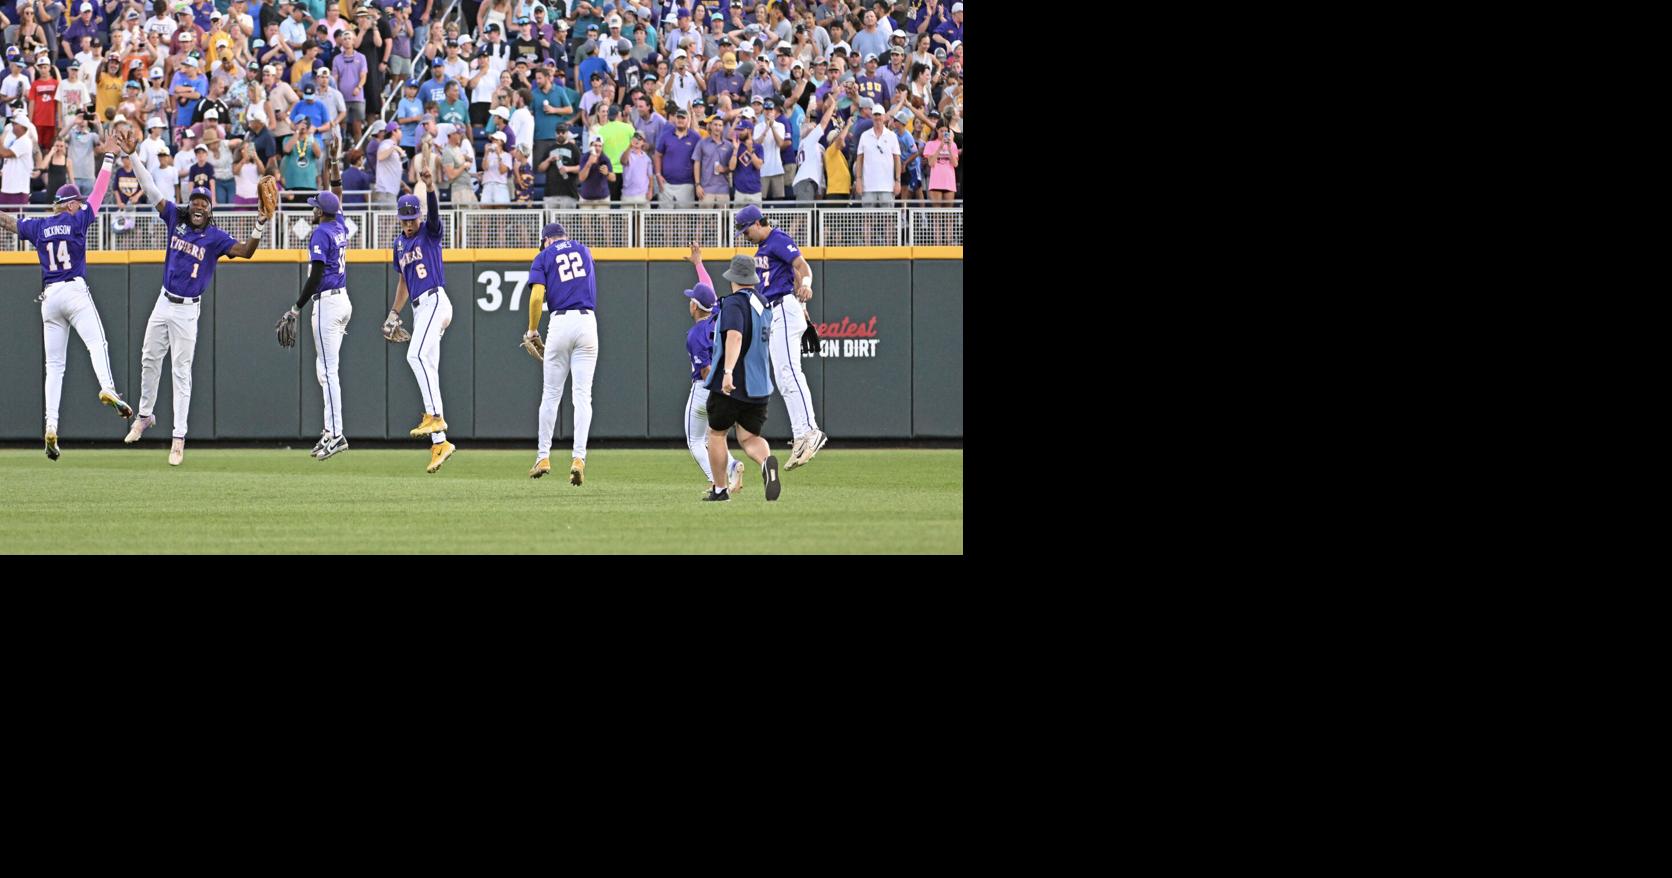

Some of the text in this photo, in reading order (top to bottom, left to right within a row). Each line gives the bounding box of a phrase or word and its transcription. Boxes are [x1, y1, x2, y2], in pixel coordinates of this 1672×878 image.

[43, 224, 72, 239] DICKINSON
[46, 240, 72, 271] 14
[169, 235, 206, 262] TIGERS
[190, 262, 200, 279] 1
[415, 263, 428, 279] 6
[555, 251, 587, 283] 22
[762, 271, 770, 287] 7
[476, 270, 549, 312] 37
[819, 338, 840, 358] ON
